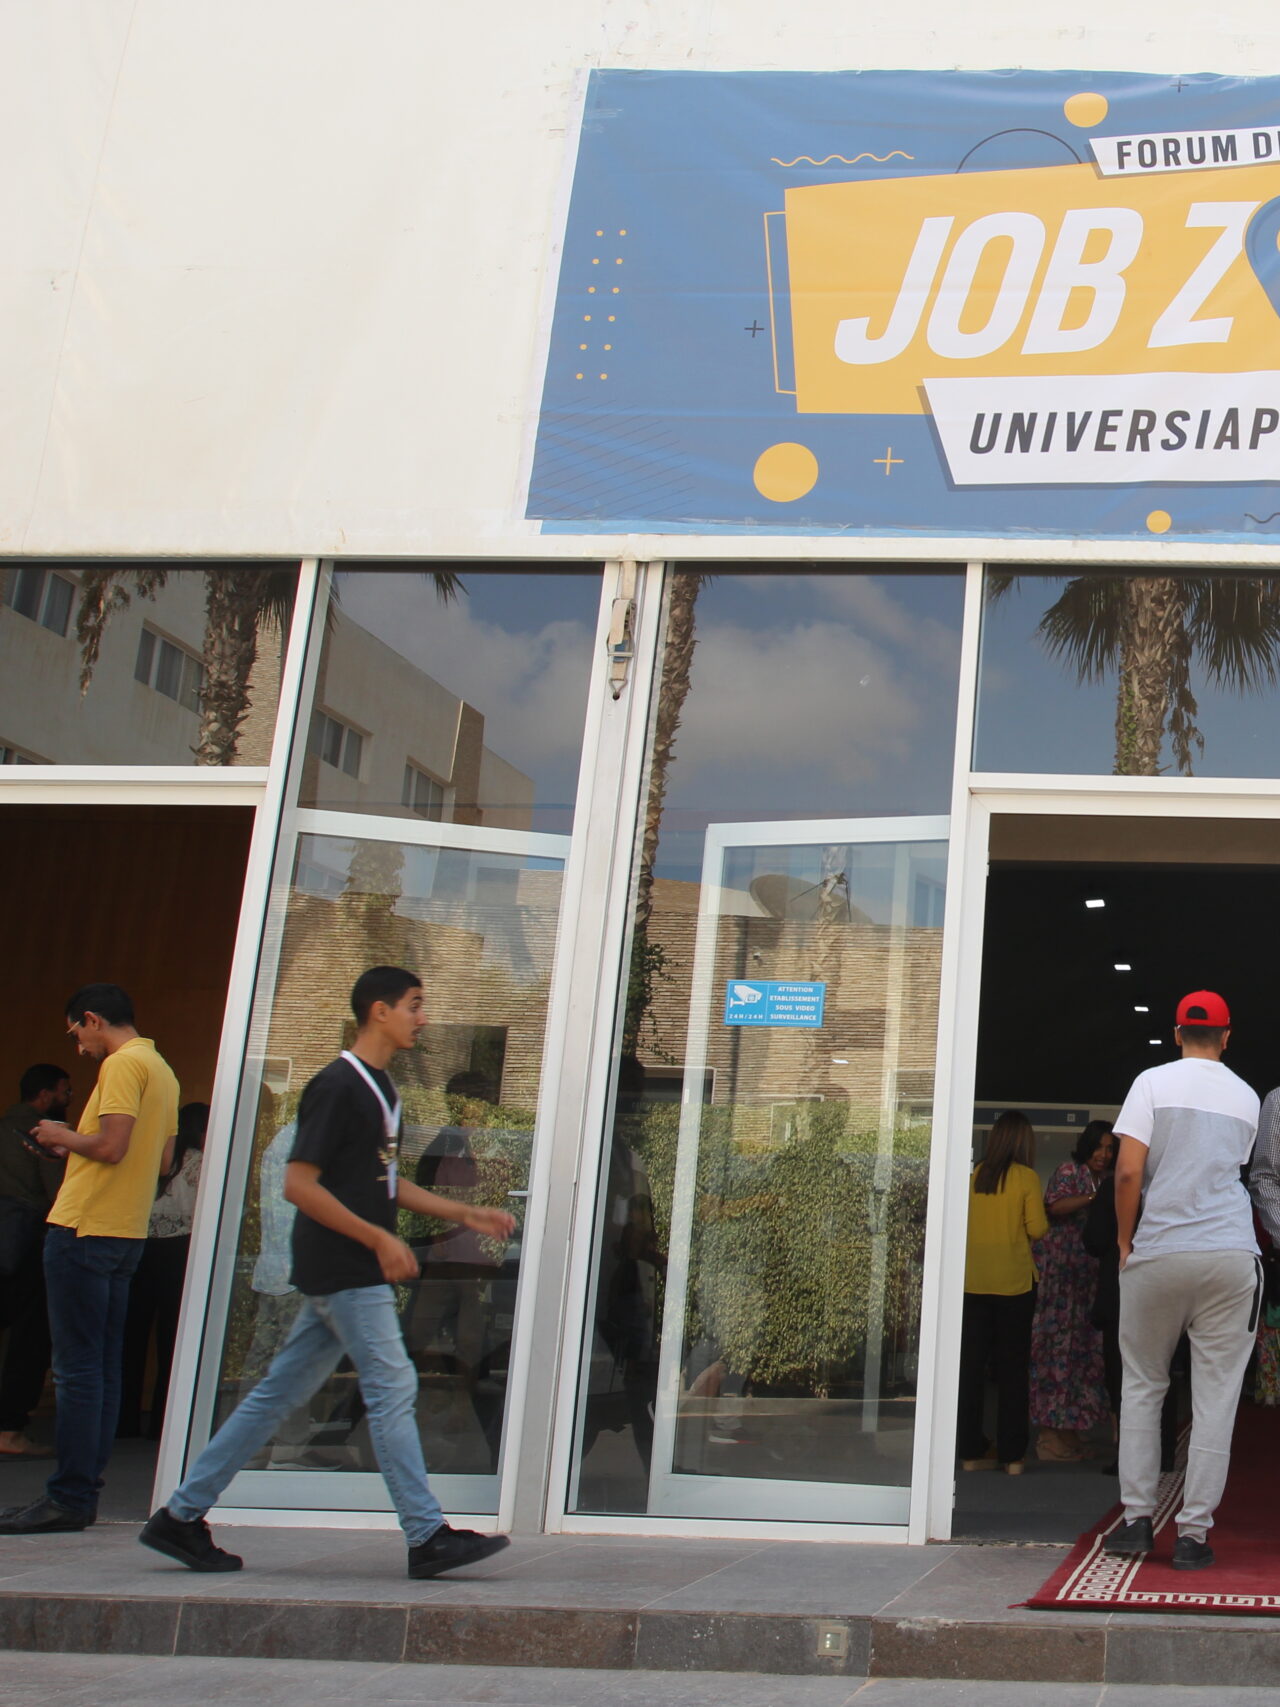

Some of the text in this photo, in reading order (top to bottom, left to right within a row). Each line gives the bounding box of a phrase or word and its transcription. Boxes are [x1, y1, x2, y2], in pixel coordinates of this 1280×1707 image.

[1116, 132, 1238, 170] FORUM
[834, 206, 1144, 365] JOB
[770, 995, 820, 1003] ETABLISSEMENT
[770, 1013, 817, 1021] SURVEILLANCE
